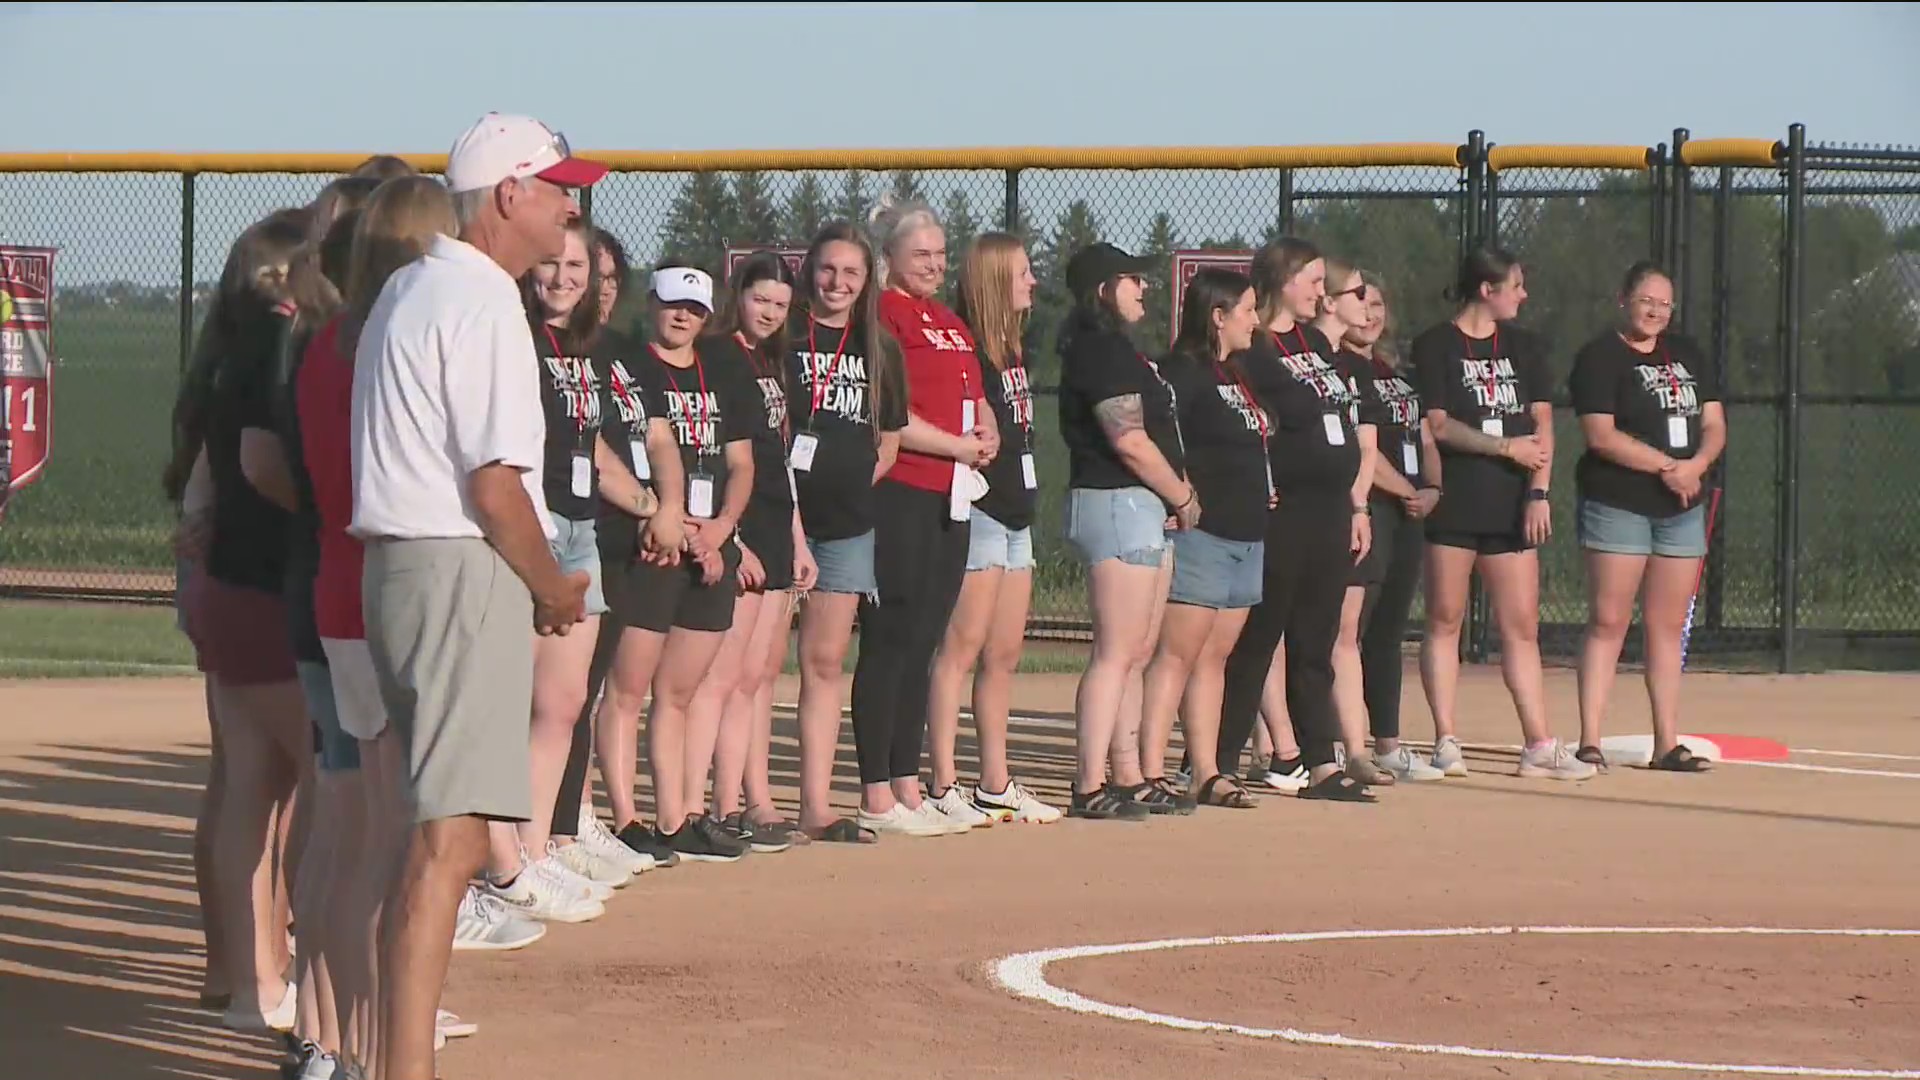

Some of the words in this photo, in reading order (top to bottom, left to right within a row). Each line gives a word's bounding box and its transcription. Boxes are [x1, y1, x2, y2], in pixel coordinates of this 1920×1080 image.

[798, 351, 867, 380] DREAM
[1462, 357, 1516, 380] DREAM
[664, 391, 720, 413] DREAM
[814, 384, 863, 414] TEAM
[1473, 383, 1518, 406] TEAM
[676, 421, 715, 445] TEAM
